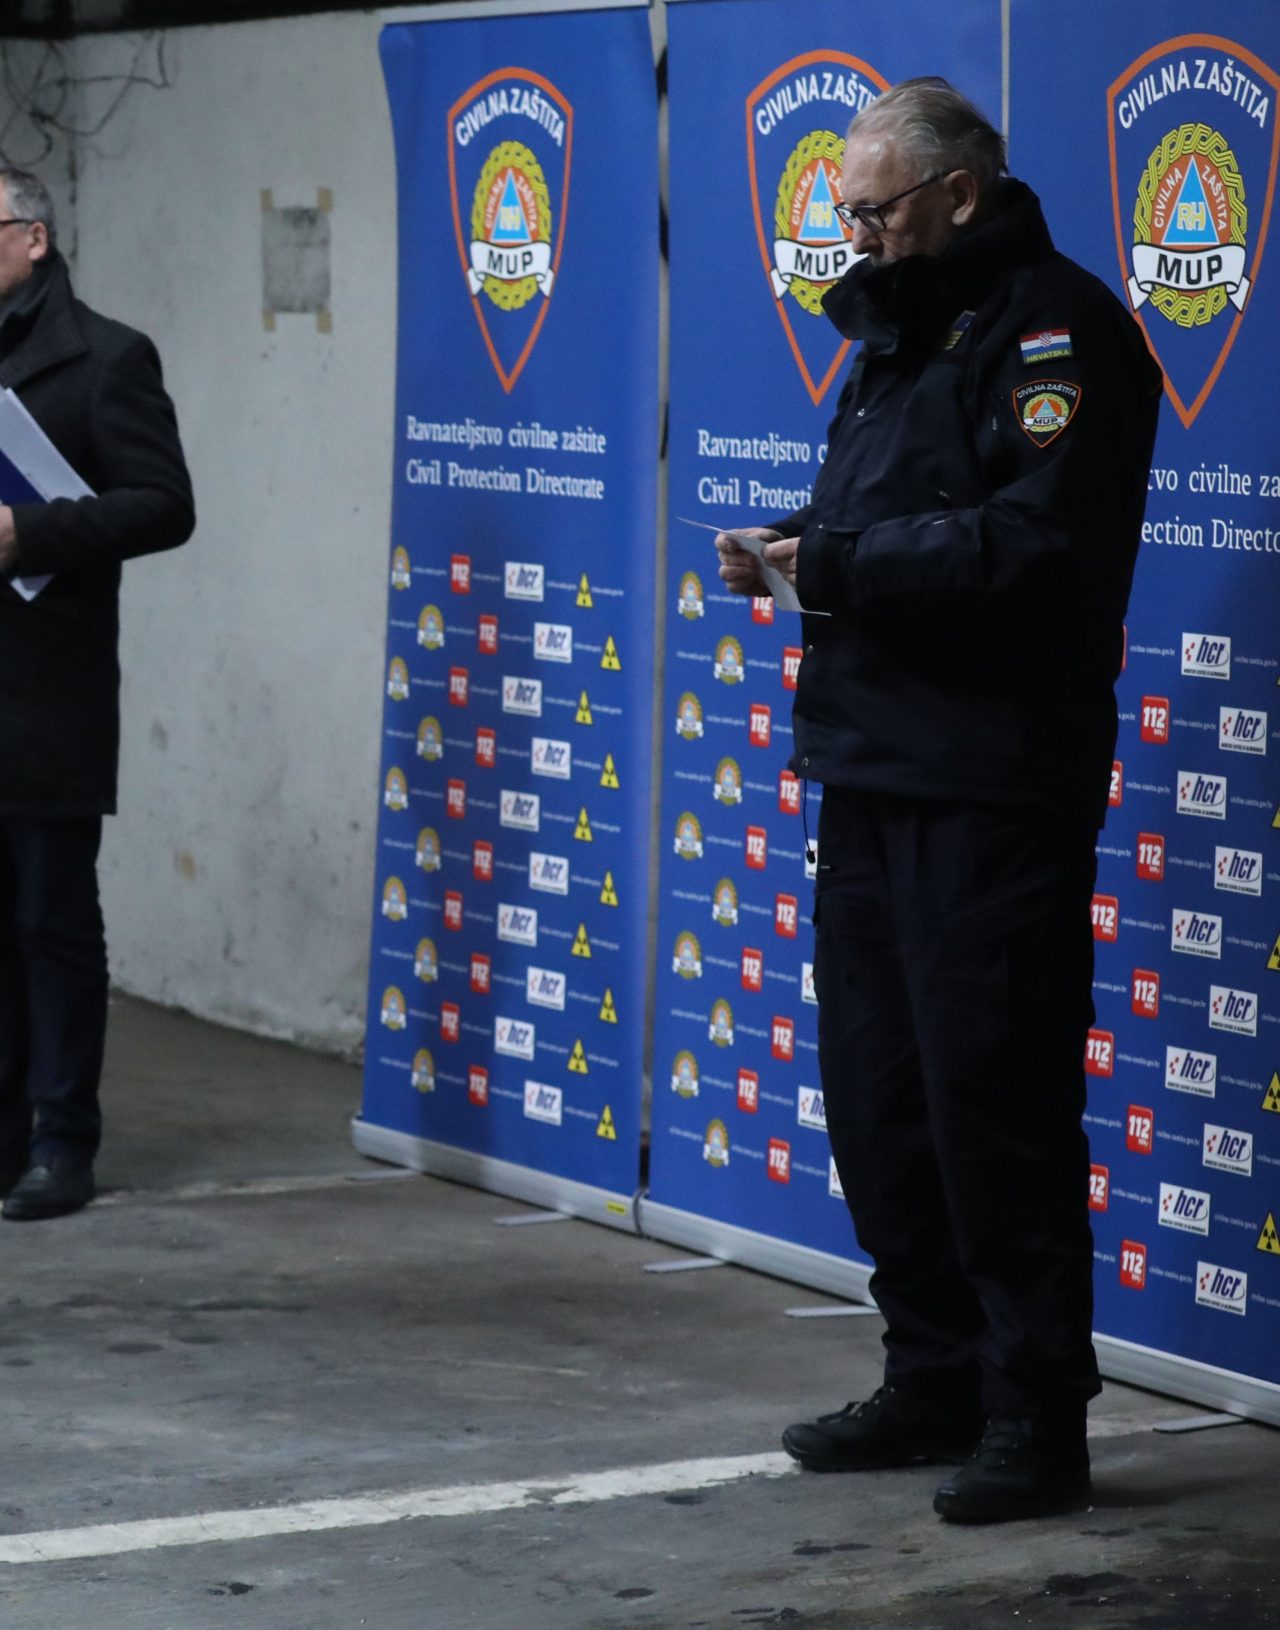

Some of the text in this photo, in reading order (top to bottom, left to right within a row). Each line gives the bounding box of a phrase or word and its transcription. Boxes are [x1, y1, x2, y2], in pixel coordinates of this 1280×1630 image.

[756, 74, 820, 135] CIVILNA
[1119, 59, 1269, 129] CIVILNA ZAŠTITA
[456, 88, 565, 146] CIVILNA ZAŠTITA
[1154, 165, 1227, 231] CIVILNA ZAŠTITA
[1176, 202, 1206, 231] RH
[487, 250, 534, 274] MUP
[794, 248, 847, 276] MUP
[1156, 253, 1223, 285] MUP
[1026, 349, 1070, 363] HRVATSKA
[1017, 384, 1077, 399] CIVILNA ZAŠTITA
[407, 415, 607, 453] Ravnateljstvo civilne zaštite
[1032, 417, 1058, 425] MUP
[697, 429, 811, 467] Ravnateljstvo
[406, 459, 605, 499] Civil Protection Directorate
[1189, 462, 1252, 496] civilne
[698, 477, 812, 511] Civil Protecti
[1141, 516, 1204, 547] ection
[1196, 637, 1225, 664] hcr
[751, 713, 768, 733] 112
[1143, 707, 1166, 729] 112
[1232, 711, 1262, 739] hcr
[781, 780, 798, 800] 112
[1192, 776, 1220, 804] hcr
[748, 834, 765, 856] 112
[1139, 843, 1162, 865] 112
[1228, 851, 1256, 880] hcr
[777, 903, 795, 924] 112
[1092, 904, 1115, 927] 112
[1186, 914, 1215, 943] hcr
[742, 957, 760, 978] 112
[1134, 979, 1157, 1003] 112
[1223, 991, 1251, 1020] hcr
[773, 1025, 792, 1047] 112
[1087, 1038, 1111, 1062] 112
[1180, 1052, 1210, 1081] hcr
[738, 1079, 757, 1101] 112
[1128, 1114, 1150, 1139] 112
[1217, 1130, 1247, 1159] hcr
[769, 1149, 787, 1170] 112
[1089, 1174, 1106, 1196] 12
[1173, 1189, 1203, 1218] hcr
[1121, 1250, 1143, 1274] 112
[1210, 1269, 1240, 1298] hcr
